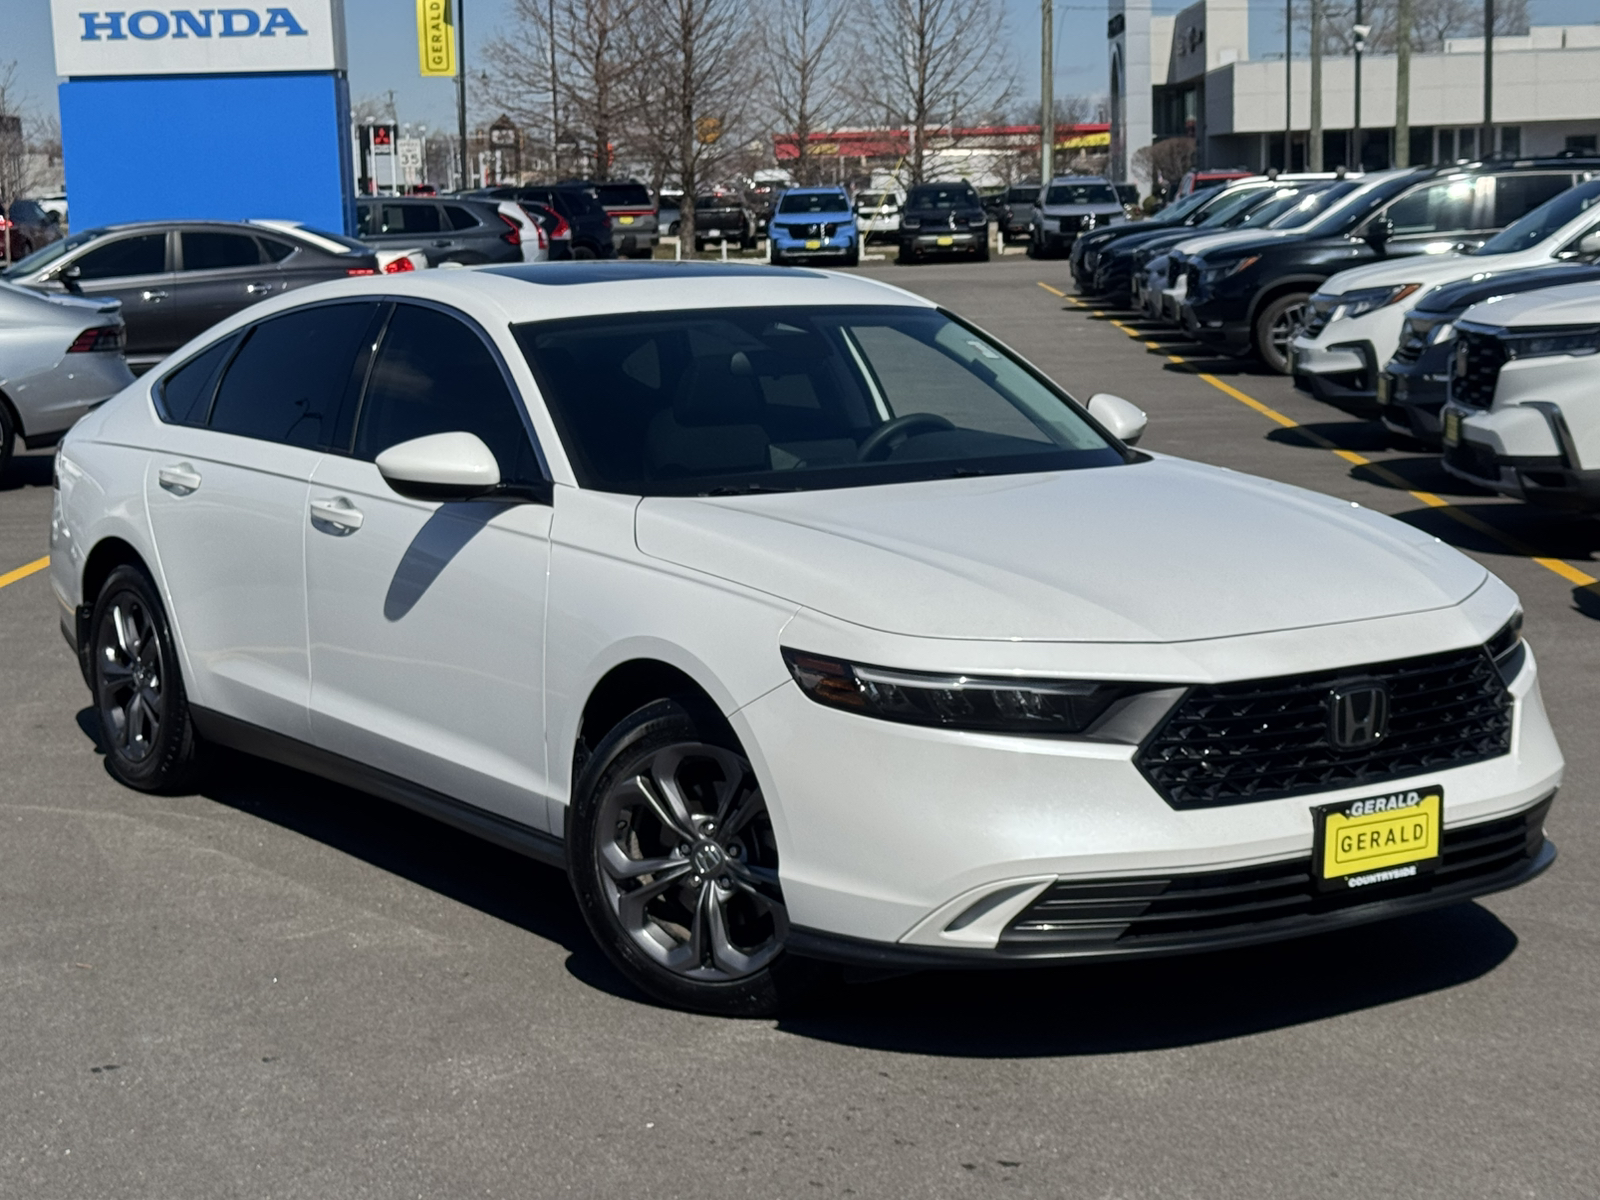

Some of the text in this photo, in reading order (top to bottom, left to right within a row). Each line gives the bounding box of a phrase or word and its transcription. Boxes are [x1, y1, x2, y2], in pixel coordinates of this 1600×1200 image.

[79, 8, 308, 41] HONDA
[430, 2, 443, 65] GERALD
[401, 153, 420, 165] 35
[1351, 792, 1419, 816] GERALD
[1341, 823, 1423, 853] GERALD
[1348, 865, 1417, 888] COUNTRYSIDE
